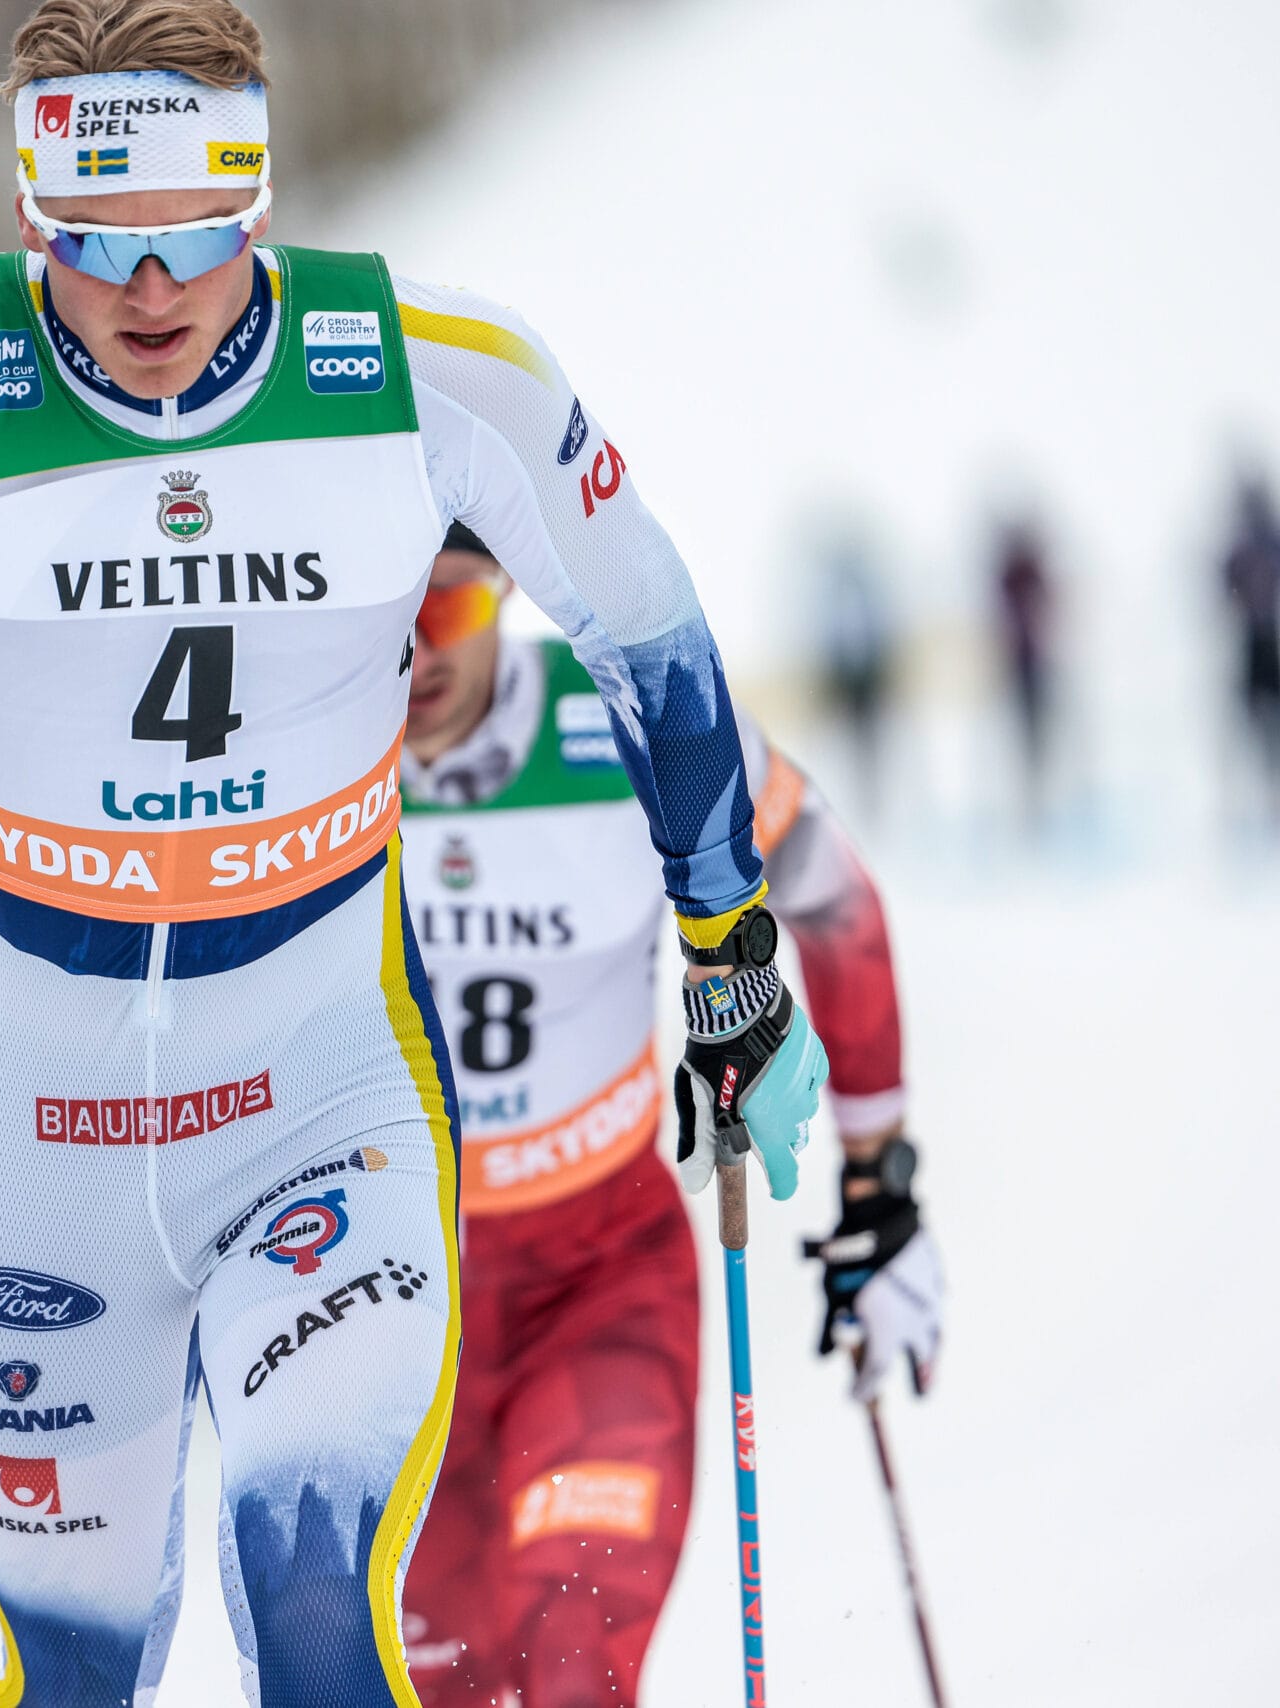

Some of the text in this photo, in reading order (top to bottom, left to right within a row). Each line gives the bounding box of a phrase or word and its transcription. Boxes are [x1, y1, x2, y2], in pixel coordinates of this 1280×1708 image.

[77, 97, 201, 118] SVENSKA
[76, 119, 139, 138] SPEL
[220, 150, 264, 168] CRAF
[327, 318, 362, 326] CROSS
[328, 326, 376, 334] COUNTRY
[12, 366, 35, 376] CUP
[309, 356, 381, 380] coop
[51, 551, 328, 611] VELTINS
[131, 625, 242, 762] 4
[102, 769, 267, 821] Lahti
[209, 764, 396, 887] SKYDDA
[423, 903, 574, 949] LTINS
[442, 974, 535, 1073] 8
[39, 1074, 268, 1140] BAUHAUS
[249, 1221, 320, 1258] Thermia
[243, 1272, 385, 1398] CRAFT
[55, 1514, 108, 1535] SPEL
